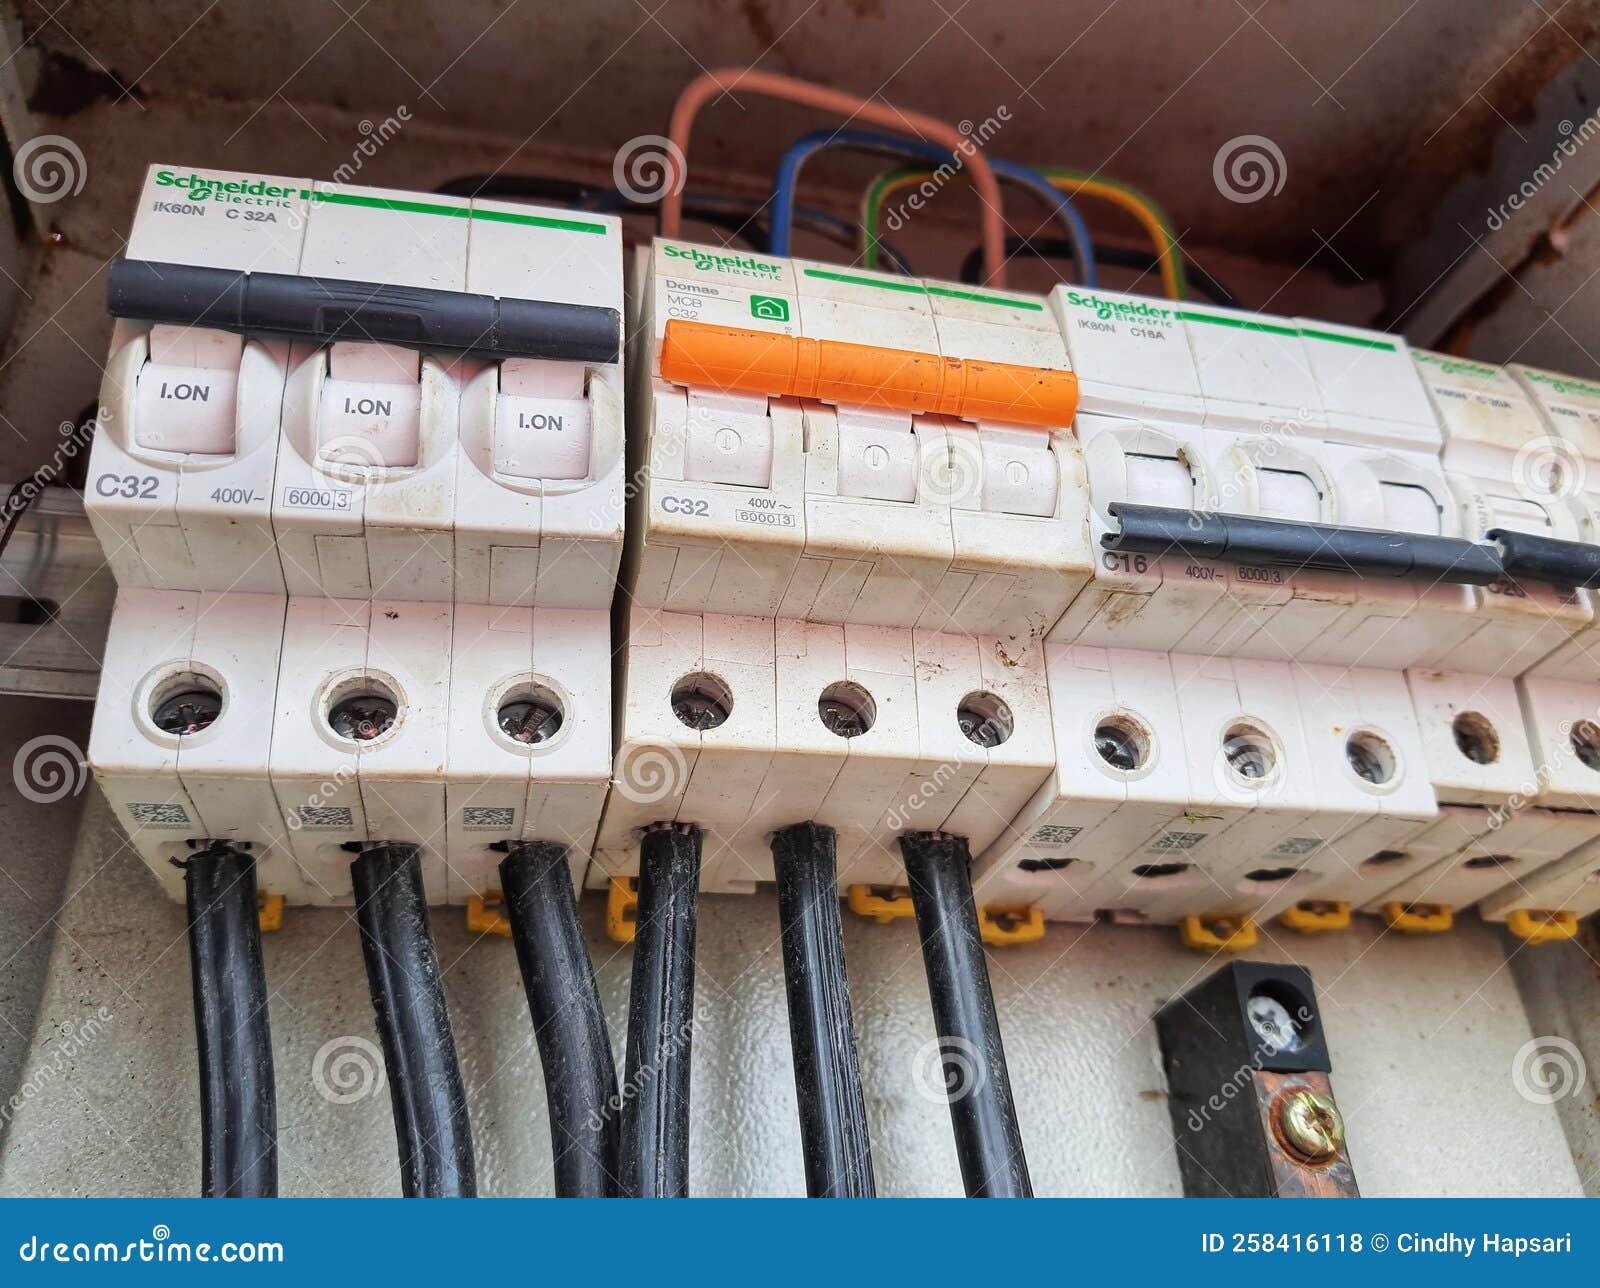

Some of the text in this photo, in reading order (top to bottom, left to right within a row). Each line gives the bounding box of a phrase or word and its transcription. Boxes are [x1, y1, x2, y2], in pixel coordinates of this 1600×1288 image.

[156, 171, 297, 198] Schneider
[215, 192, 292, 208] Electric
[663, 245, 782, 273] Schneider
[717, 265, 783, 282] Electric
[667, 295, 703, 308] MCB
[1067, 292, 1171, 319] Schneider
[668, 307, 699, 320] C32
[1116, 313, 1173, 329] Electric
[160, 382, 210, 402] I.ON
[344, 397, 392, 416] I.ON
[519, 413, 563, 431] I.ON
[96, 473, 160, 499] C32
[660, 496, 709, 517] C32
[1102, 551, 1148, 574] C16
